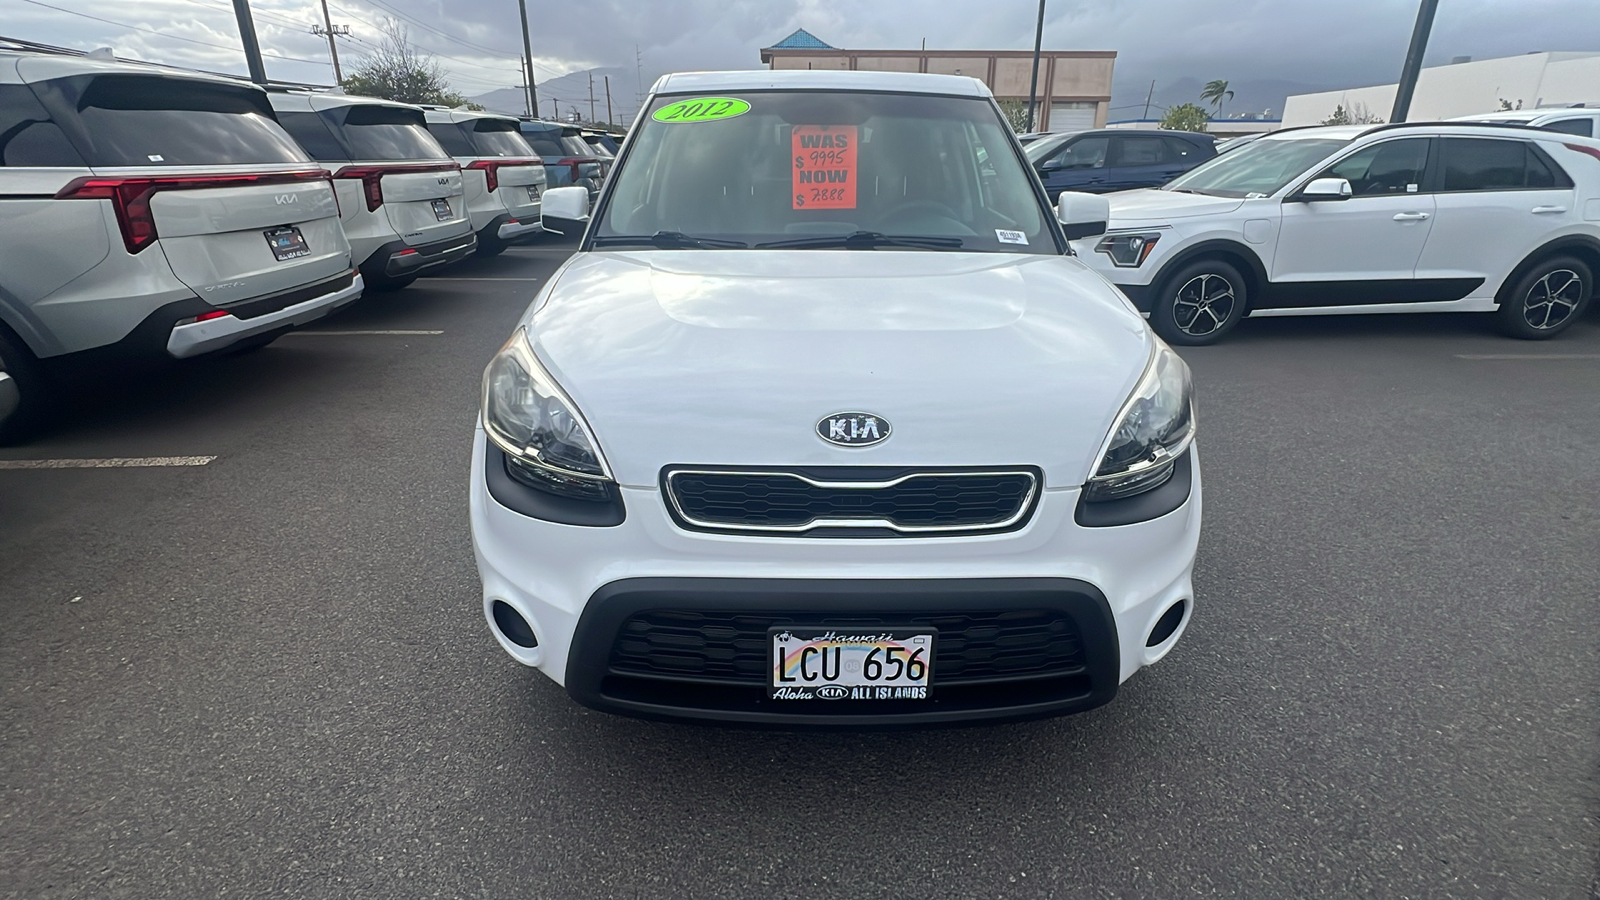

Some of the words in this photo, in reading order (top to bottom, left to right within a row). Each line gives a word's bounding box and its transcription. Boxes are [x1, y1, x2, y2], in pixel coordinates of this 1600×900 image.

[664, 101, 734, 120] 2012
[800, 134, 848, 149] WAS
[795, 155, 805, 169] $
[810, 149, 848, 166] 9995
[799, 170, 848, 184] NOW
[275, 193, 298, 205] KIA
[795, 193, 805, 207] $
[829, 418, 880, 441] KIA
[812, 631, 894, 642] Hawaii
[779, 646, 841, 682] LCU
[863, 646, 925, 681] 656
[772, 687, 814, 700] Aloha
[821, 688, 844, 698] KIA
[850, 686, 872, 700] ALL
[875, 686, 927, 700] ISLANDS
